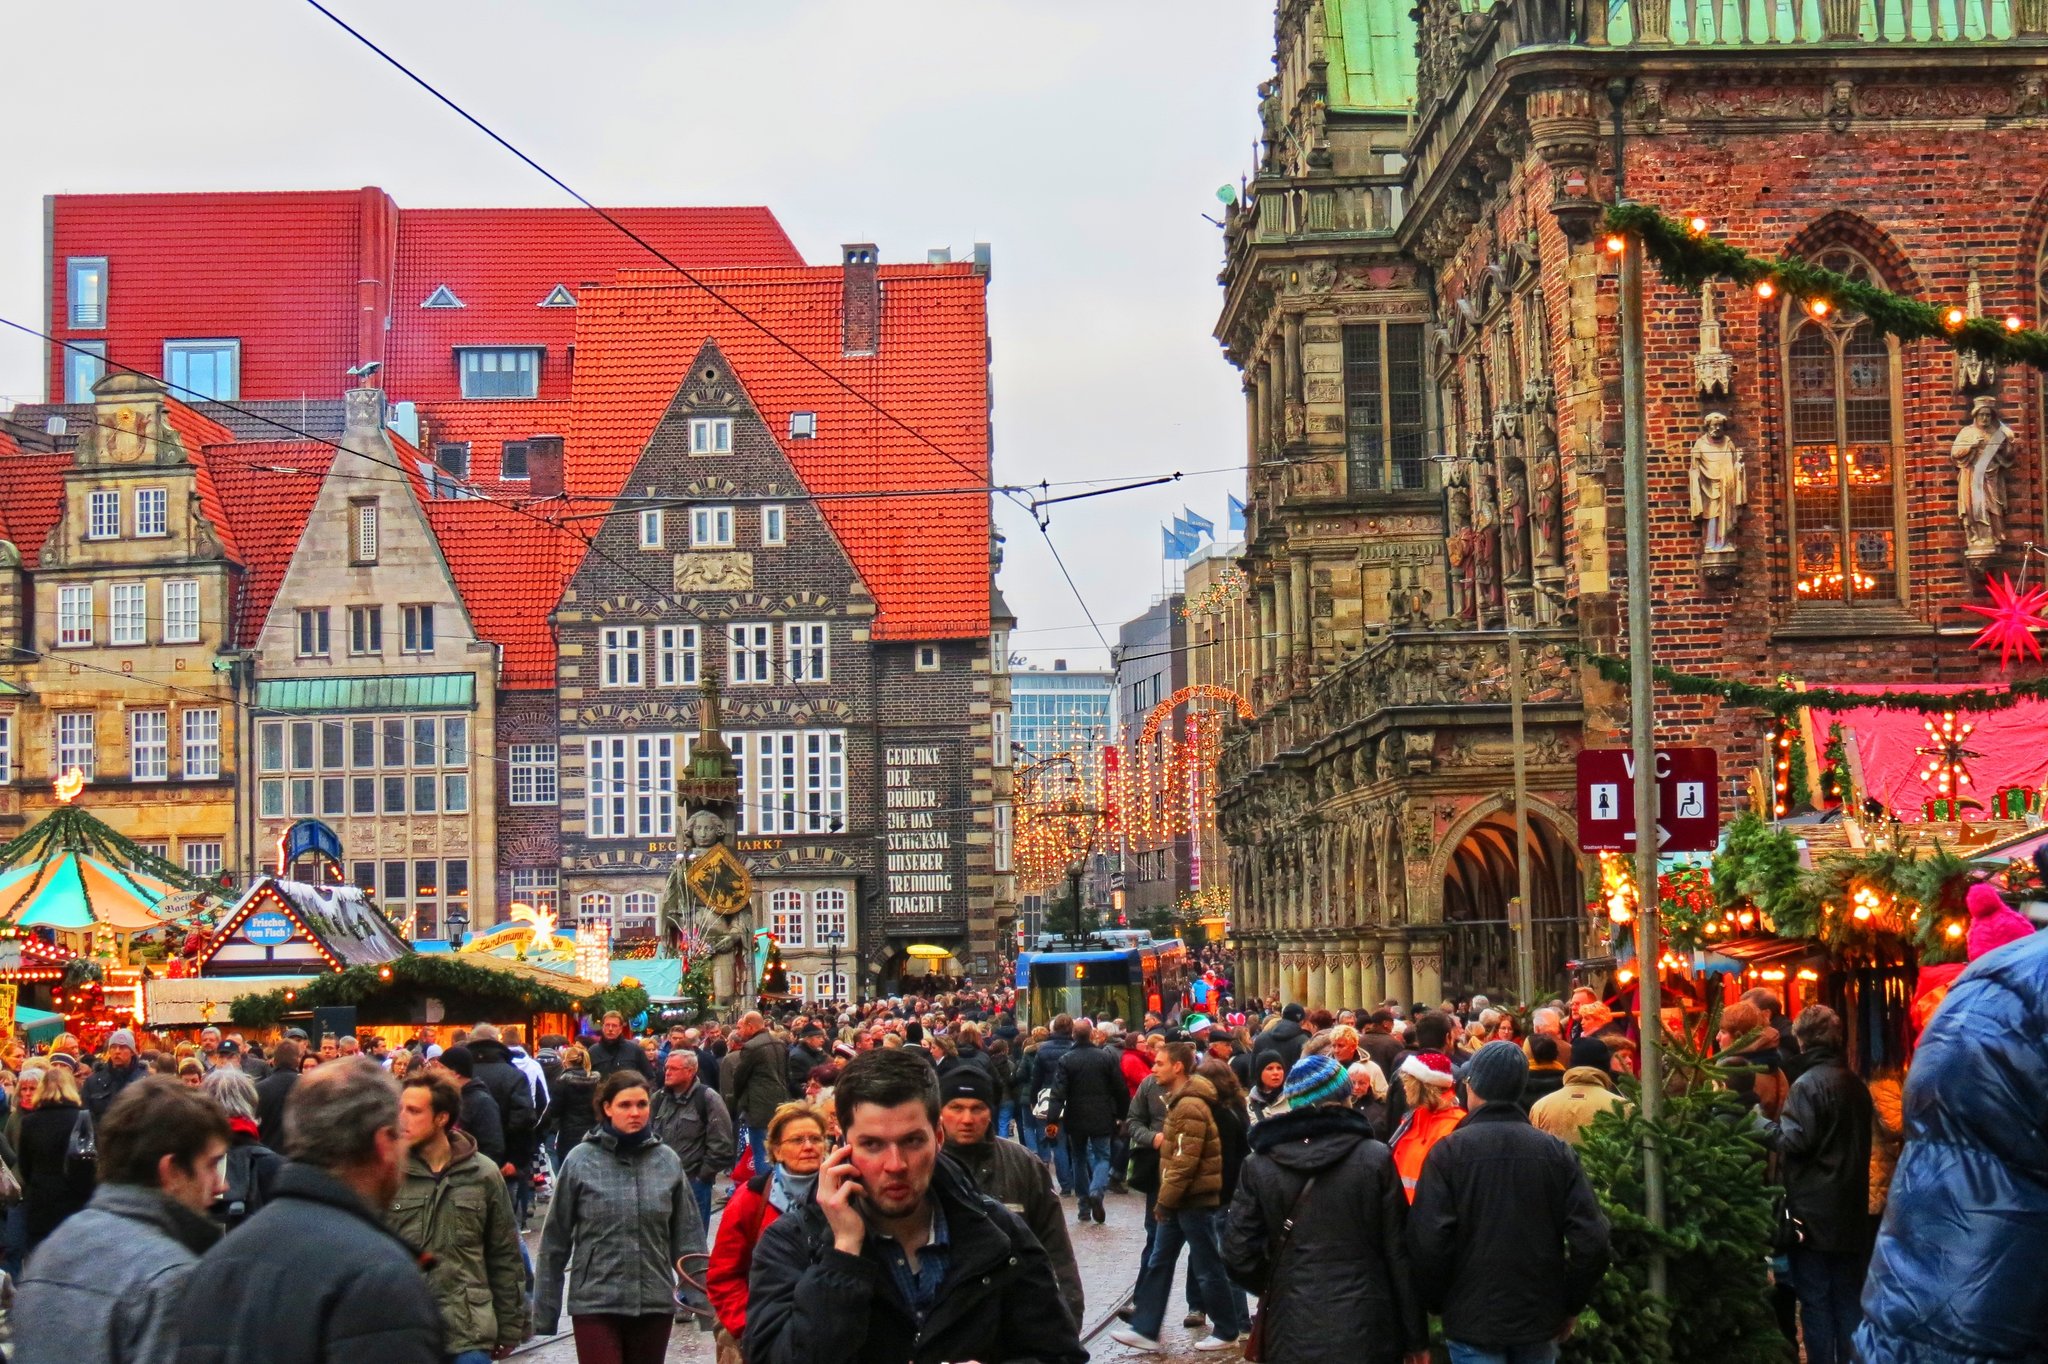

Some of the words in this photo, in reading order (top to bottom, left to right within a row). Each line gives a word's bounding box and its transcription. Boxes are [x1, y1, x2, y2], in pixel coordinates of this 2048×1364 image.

[886, 748, 940, 766] GEDENKE
[887, 769, 910, 787] DER
[887, 788, 942, 808] BRÜDER,
[887, 812, 906, 830] DIE
[911, 812, 933, 829] DAS
[888, 832, 951, 850] SCHICKSAL
[888, 854, 943, 872] UNSERER
[888, 875, 952, 893] TRENNUNG
[889, 897, 934, 914] TRAGEN
[938, 896, 943, 913] !
[252, 917, 286, 927] Frisches
[265, 928, 285, 937] Fisch
[1076, 965, 1083, 978] 2
